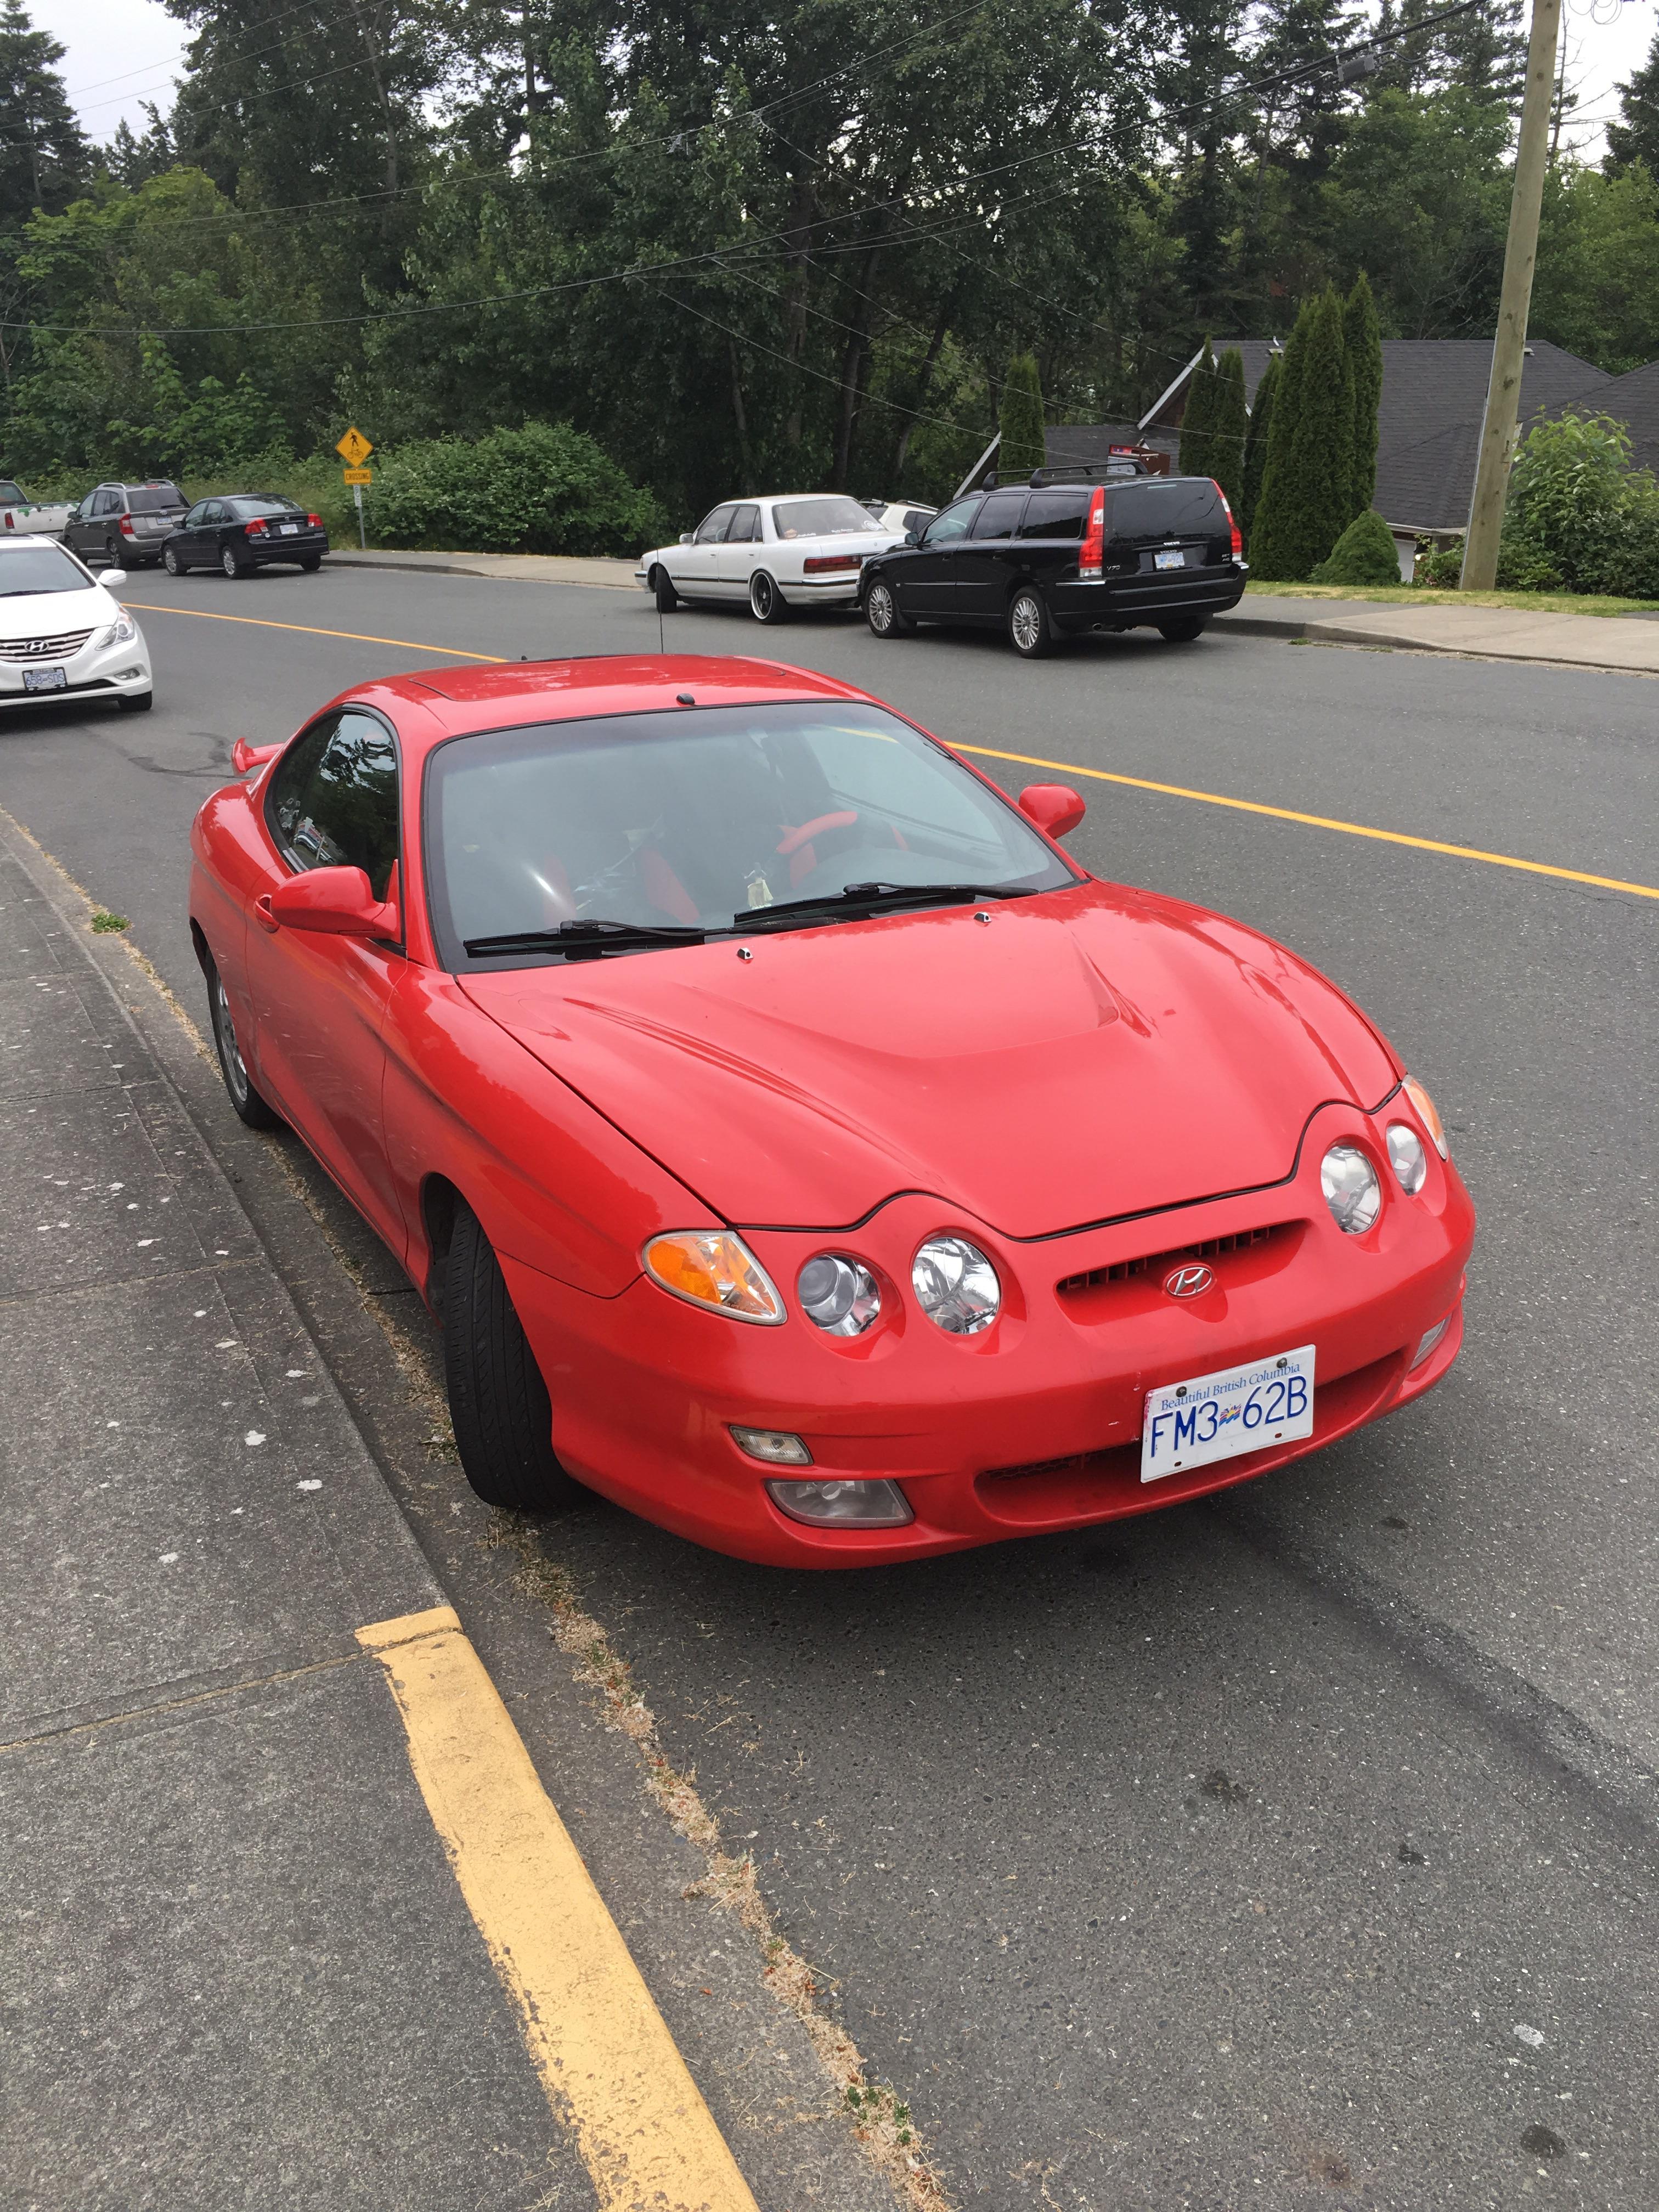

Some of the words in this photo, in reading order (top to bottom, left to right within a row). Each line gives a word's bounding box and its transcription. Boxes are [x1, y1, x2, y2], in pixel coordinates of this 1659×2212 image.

[1151, 1401, 1218, 1458] FM3
[1243, 1375, 1307, 1429] 62B
[1161, 1387, 1210, 1410] Beautiful
[1213, 1377, 1246, 1396] British
[1249, 1363, 1300, 1385] Columbia
